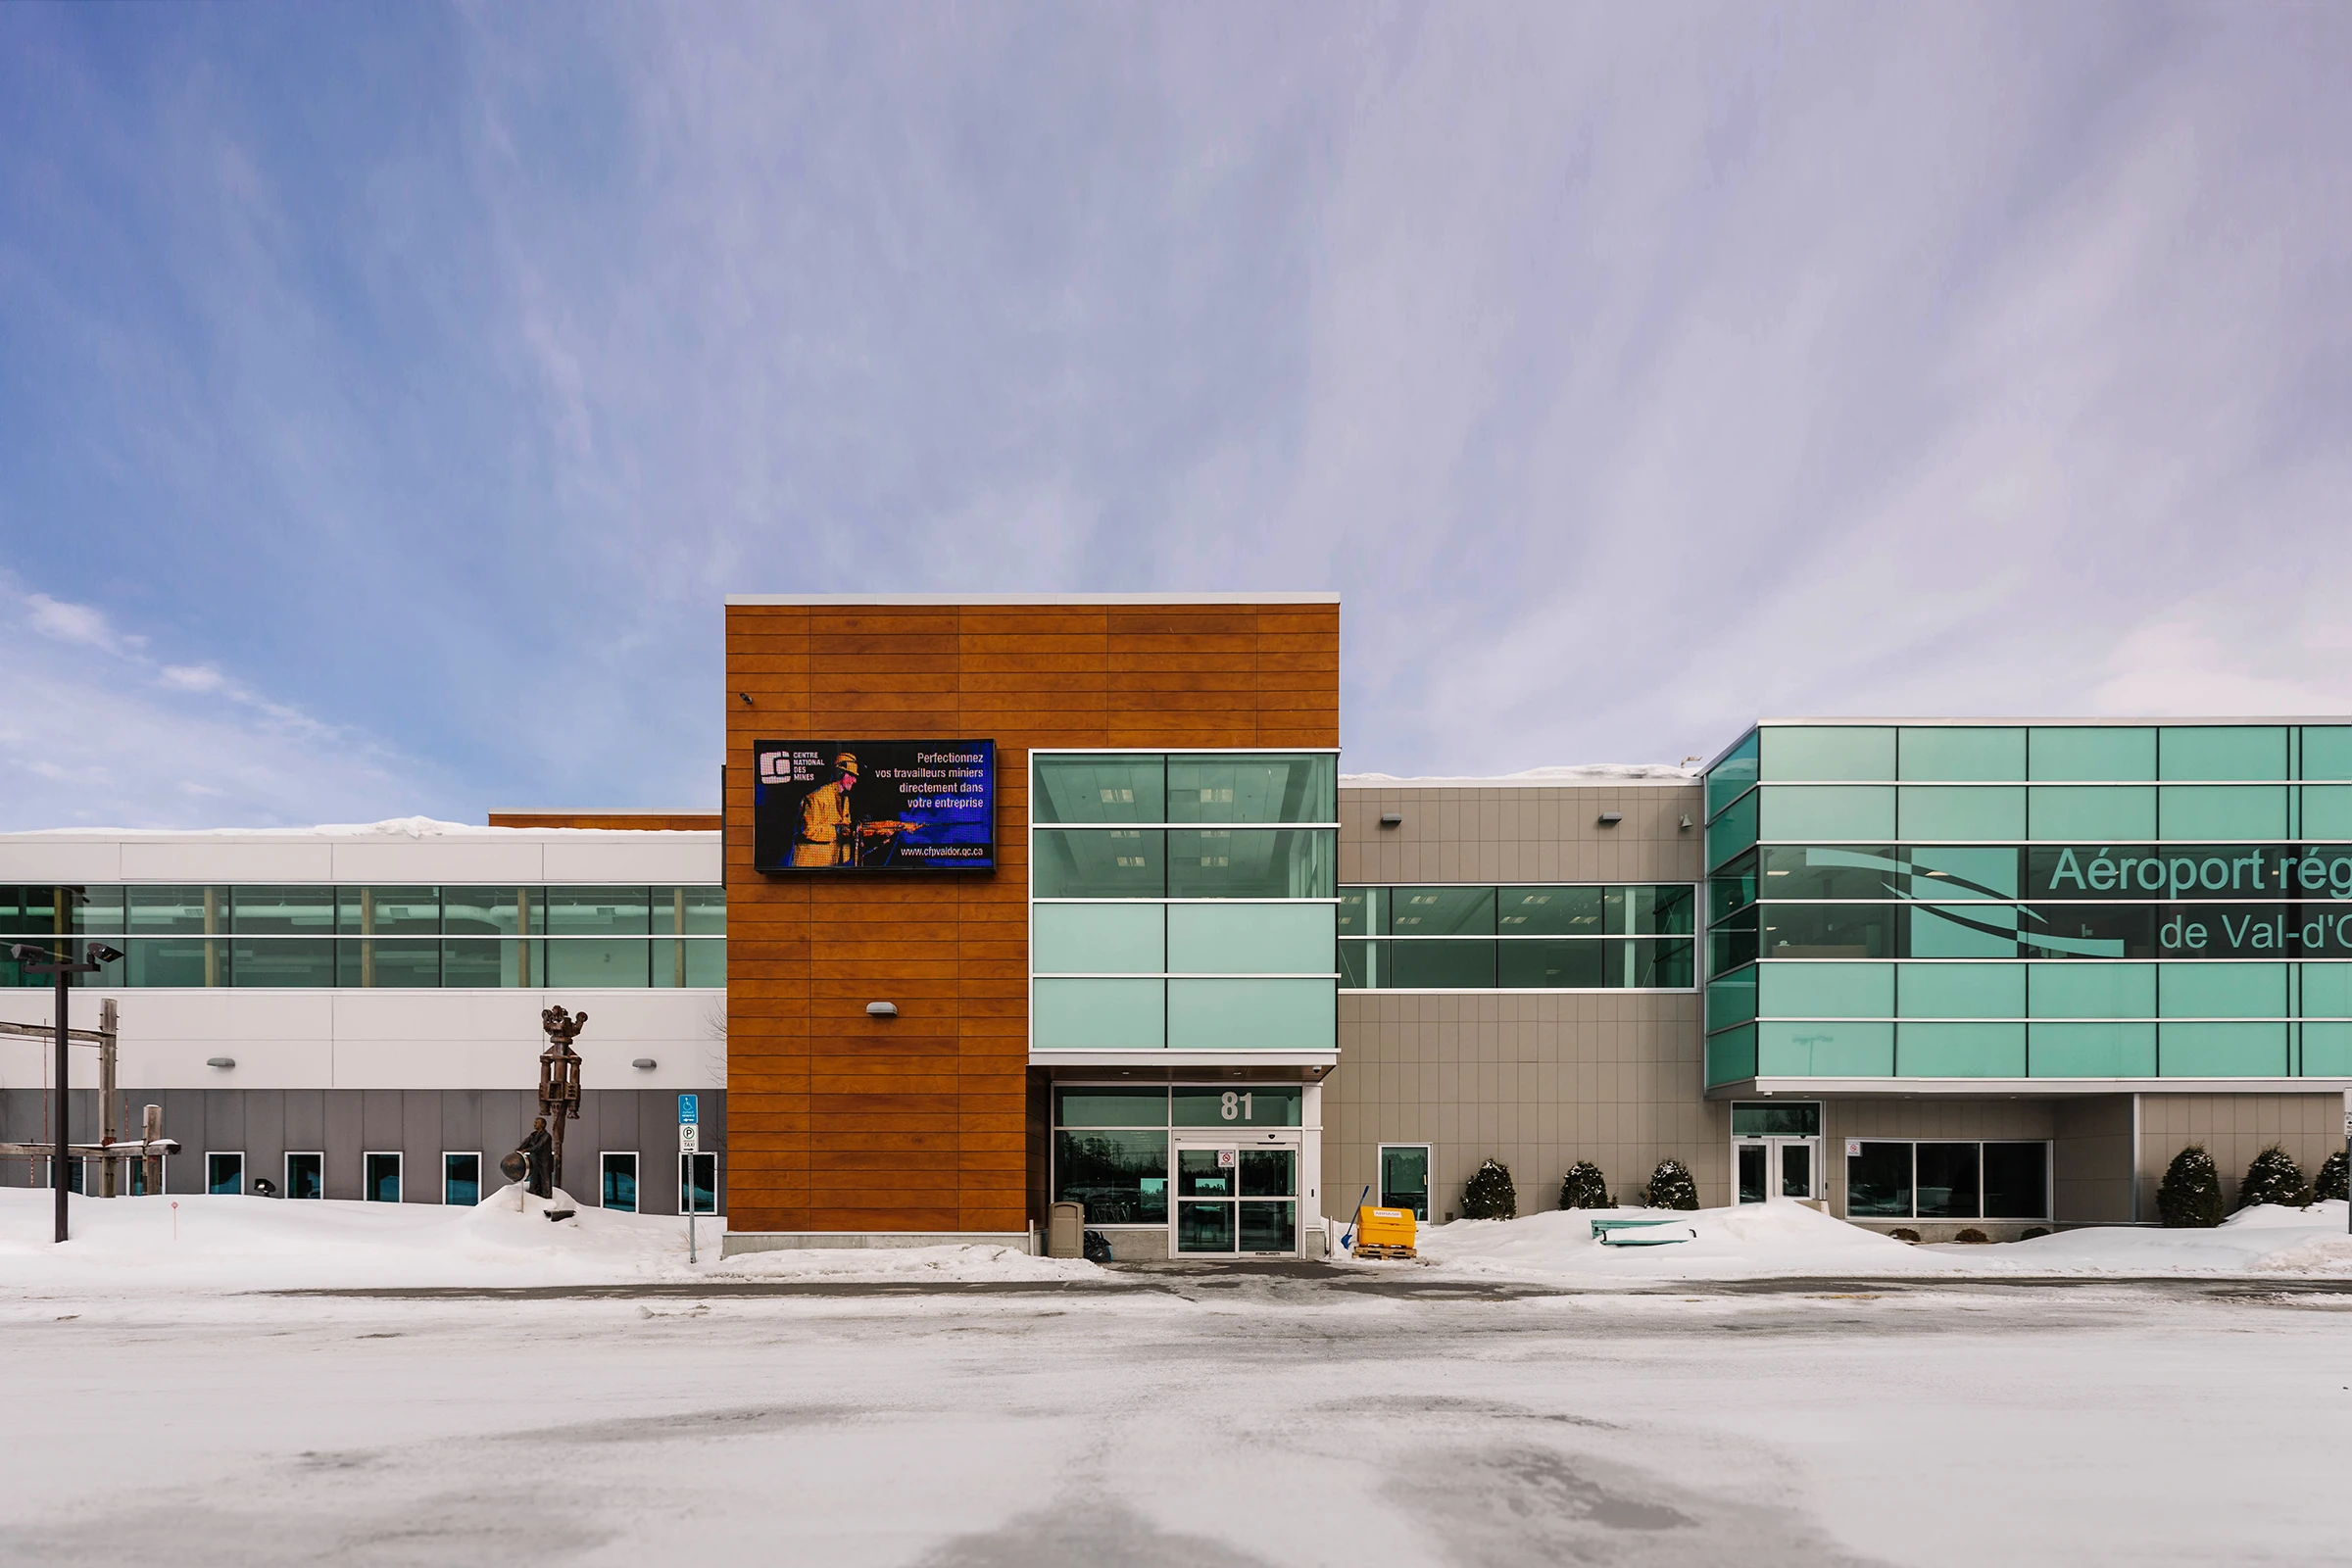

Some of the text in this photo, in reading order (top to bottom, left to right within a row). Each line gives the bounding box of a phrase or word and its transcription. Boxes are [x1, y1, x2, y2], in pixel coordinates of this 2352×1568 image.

[917, 752, 984, 763] Perfectionnez
[875, 767, 984, 778] vos travailleurs miniers
[899, 782, 984, 793] directement dans
[906, 797, 984, 809] votre entreprise
[901, 846, 984, 858] www.cfpvaldor.qc.ca
[2048, 847, 2265, 900] Aéroport
[2160, 914, 2208, 949] de
[1221, 1091, 1252, 1120] 81
